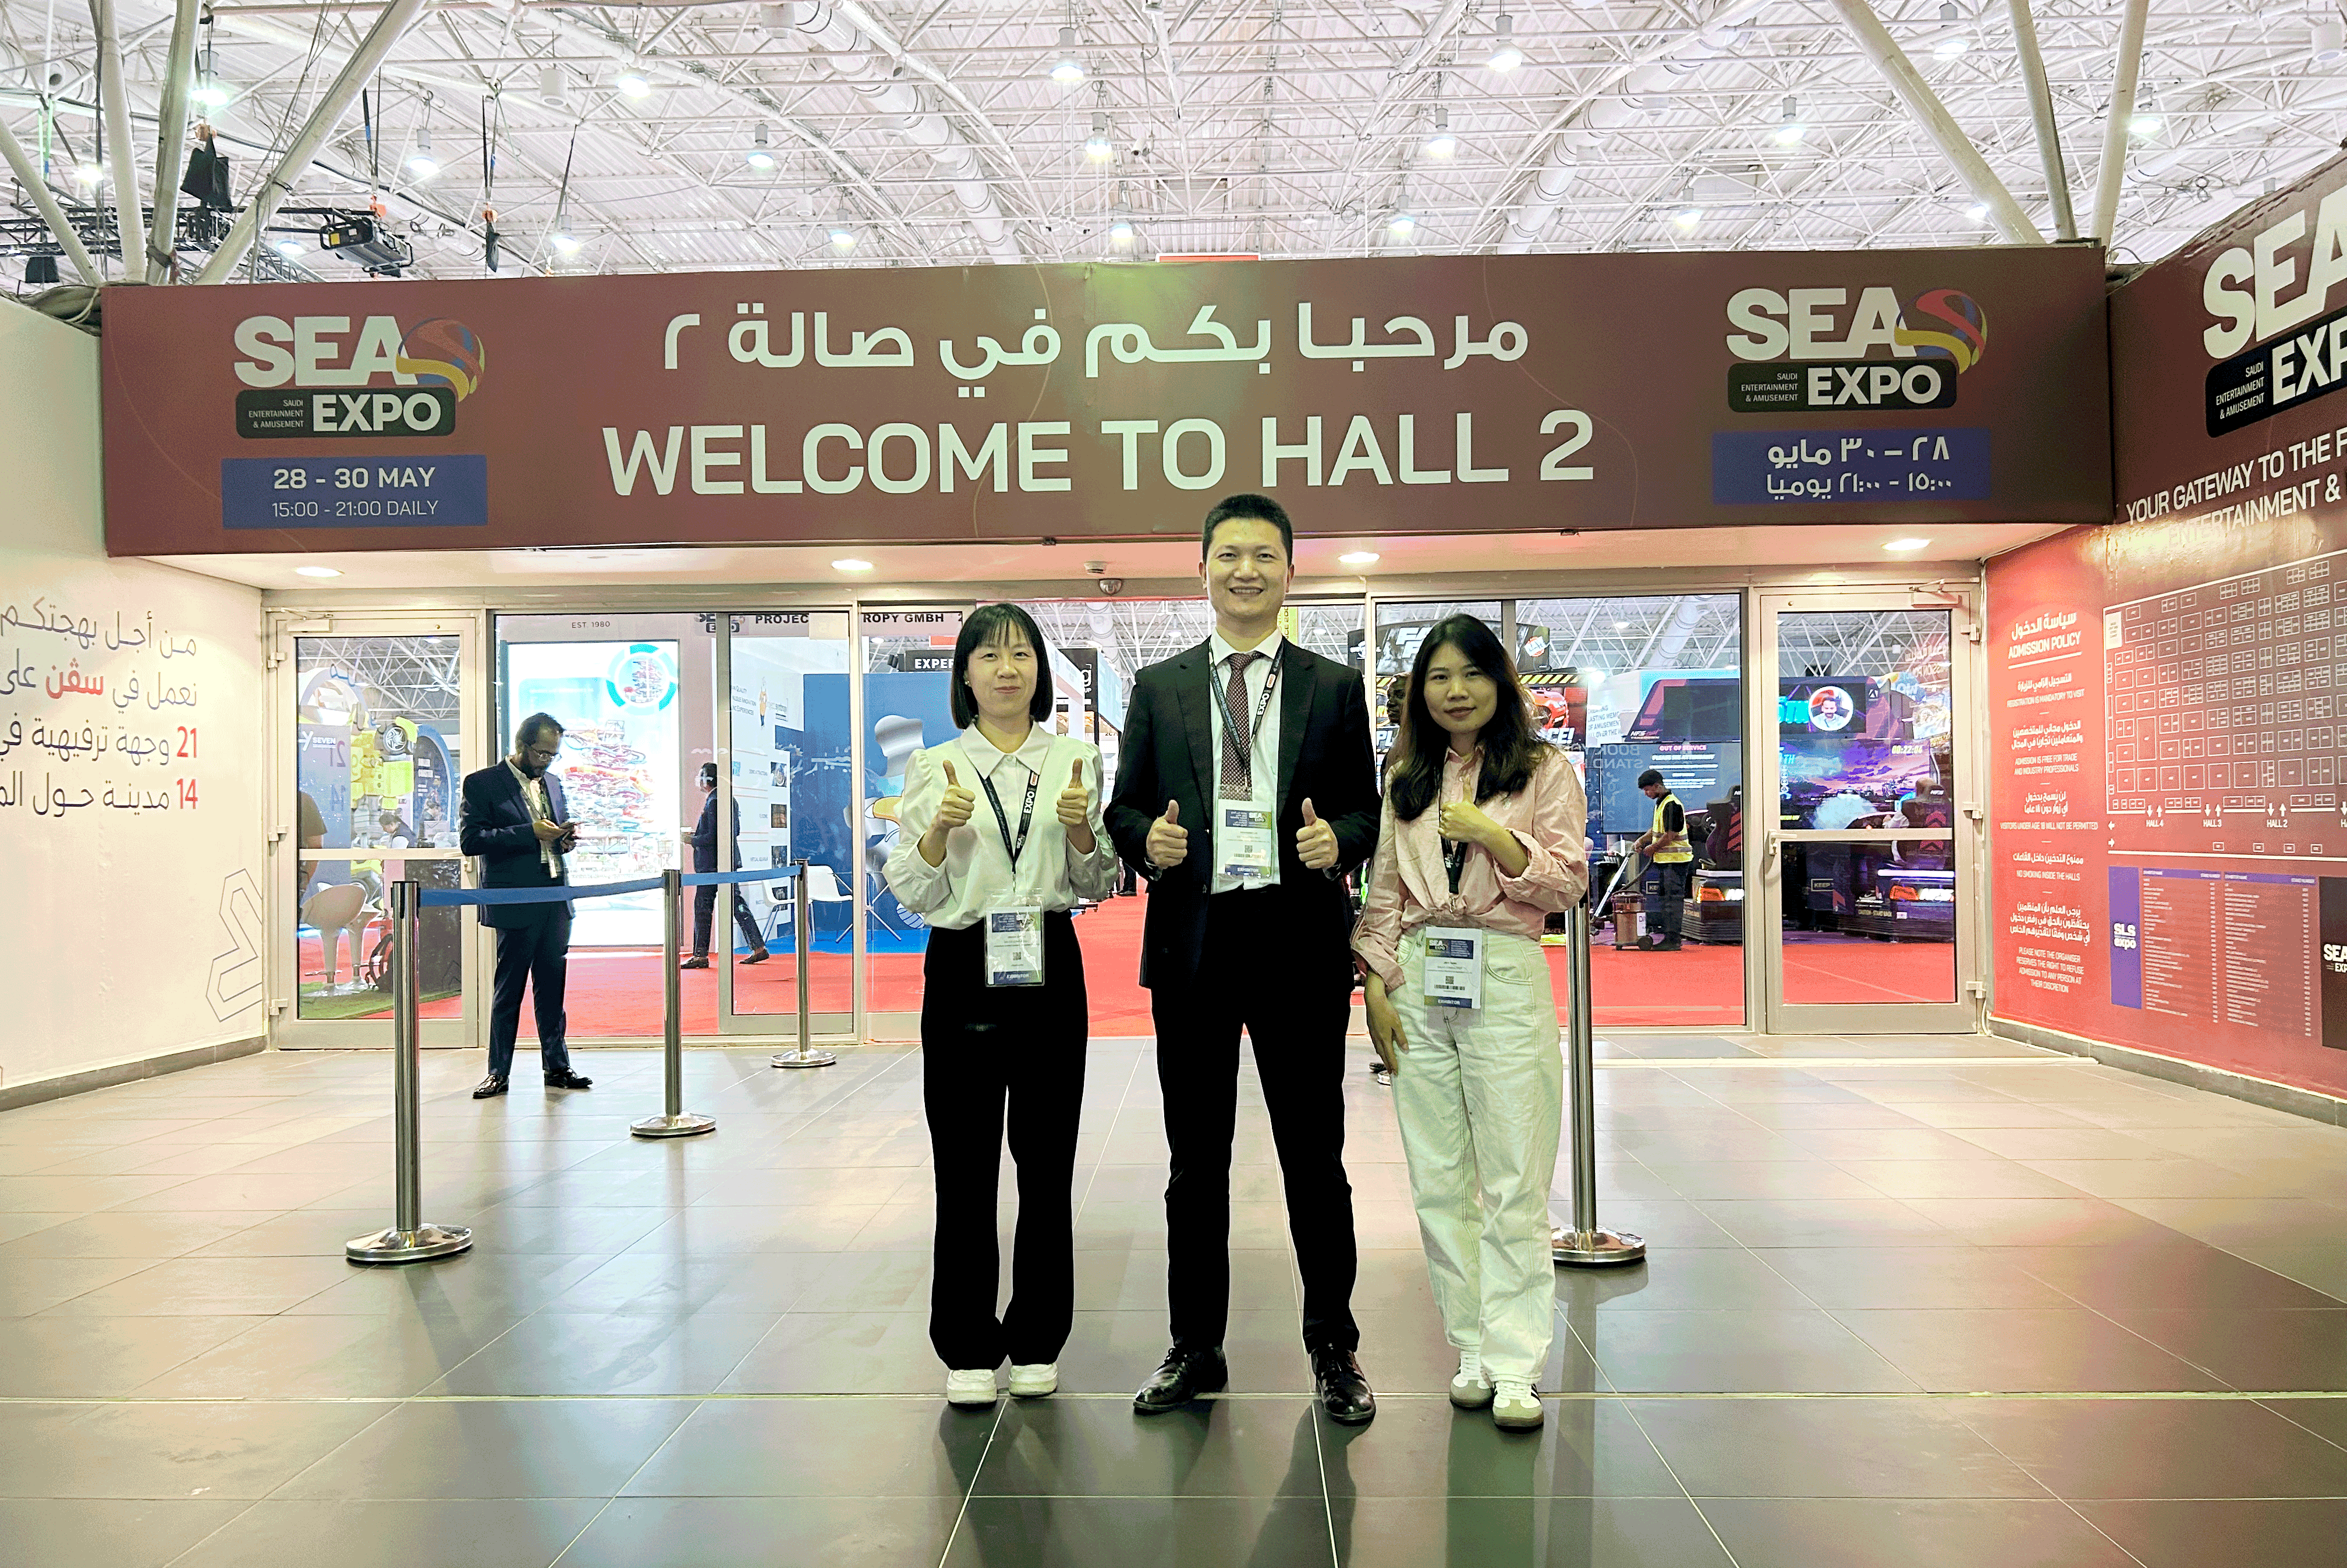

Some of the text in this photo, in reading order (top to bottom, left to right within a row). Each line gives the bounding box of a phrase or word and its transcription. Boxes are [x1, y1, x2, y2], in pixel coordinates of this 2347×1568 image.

[1726, 287, 1917, 361] SEA
[234, 315, 418, 388] SEA
[664, 302, 1529, 399] مرحبا بكم في صالة ٢
[2272, 315, 2347, 405] EXP
[1777, 373, 1798, 381] SAUDI
[2245, 361, 2264, 378] SAUDI
[1741, 383, 1798, 391] ENTERTAINMENT
[1807, 365, 1941, 405] EXPO
[2216, 377, 2264, 406] ENTERTAINMENT
[1753, 393, 1798, 402] AMUSEMENT
[2220, 392, 2264, 419] & AMUSEMENT
[249, 409, 303, 418] ENTERTAINMENT
[313, 392, 441, 431] EXPO
[602, 409, 1594, 496] WELCOME TO HALL 2
[1767, 439, 1832, 469] مايو
[274, 469, 307, 489] 28
[335, 468, 369, 488] 30
[378, 467, 436, 487] MAY
[1766, 474, 1831, 500] يوميا
[2126, 432, 2331, 525] YOUR GATEWAY TO THE
[2325, 473, 2341, 502] &
[272, 502, 318, 517] 15:00
[336, 501, 381, 516] 21:00
[387, 501, 438, 516] DAILY
[1, 597, 196, 659] من أجل بهجتكم
[756, 615, 809, 623] PROJEC
[863, 614, 899, 622] ROPY
[2011, 612, 2077, 641] سياسة الدخول
[2008, 630, 2082, 659] ADMISSION POLICY
[0, 648, 36, 694] على
[113, 670, 139, 714] في
[147, 672, 197, 710] نعمل
[2040, 692, 2066, 703] MANDATORY
[2066, 690, 2072, 698] TO
[2073, 689, 2084, 698] VISIT
[1257, 693, 1270, 715] EXPO
[1594, 721, 1620, 729] AMUSEMEN
[31, 718, 108, 762] ترفيهية
[116, 726, 169, 766] وجهة
[177, 726, 197, 758] 21
[2023, 766, 2043, 775] INDUSTRY
[2044, 764, 2079, 773] PROFESSIONALS
[2042, 755, 2052, 763] FREE
[2062, 753, 2077, 761] TRADE
[33, 772, 197, 817] 14 مدينة حول
[1024, 791, 1034, 814] EXPO
[2032, 822, 2040, 830] AGE
[2056, 822, 2066, 830] NOT
[2146, 819, 2164, 827] HALL 4
[2203, 820, 2222, 828] HALL 3
[2267, 820, 2288, 828] HALL 2
[2057, 872, 2065, 880] THE
[2065, 872, 2080, 881] HALLS
[2114, 923, 2136, 937] SLS
[2019, 947, 2055, 959] PLEASE NOTE THE
[2114, 938, 2136, 950] expo
[2037, 959, 2046, 968] THE
[2047, 961, 2059, 970] RIGHT
[2060, 963, 2066, 971] TO
[2066, 964, 2084, 975] REFUSE
[2041, 970, 2047, 978] TO
[2057, 973, 2075, 984] PERSON
